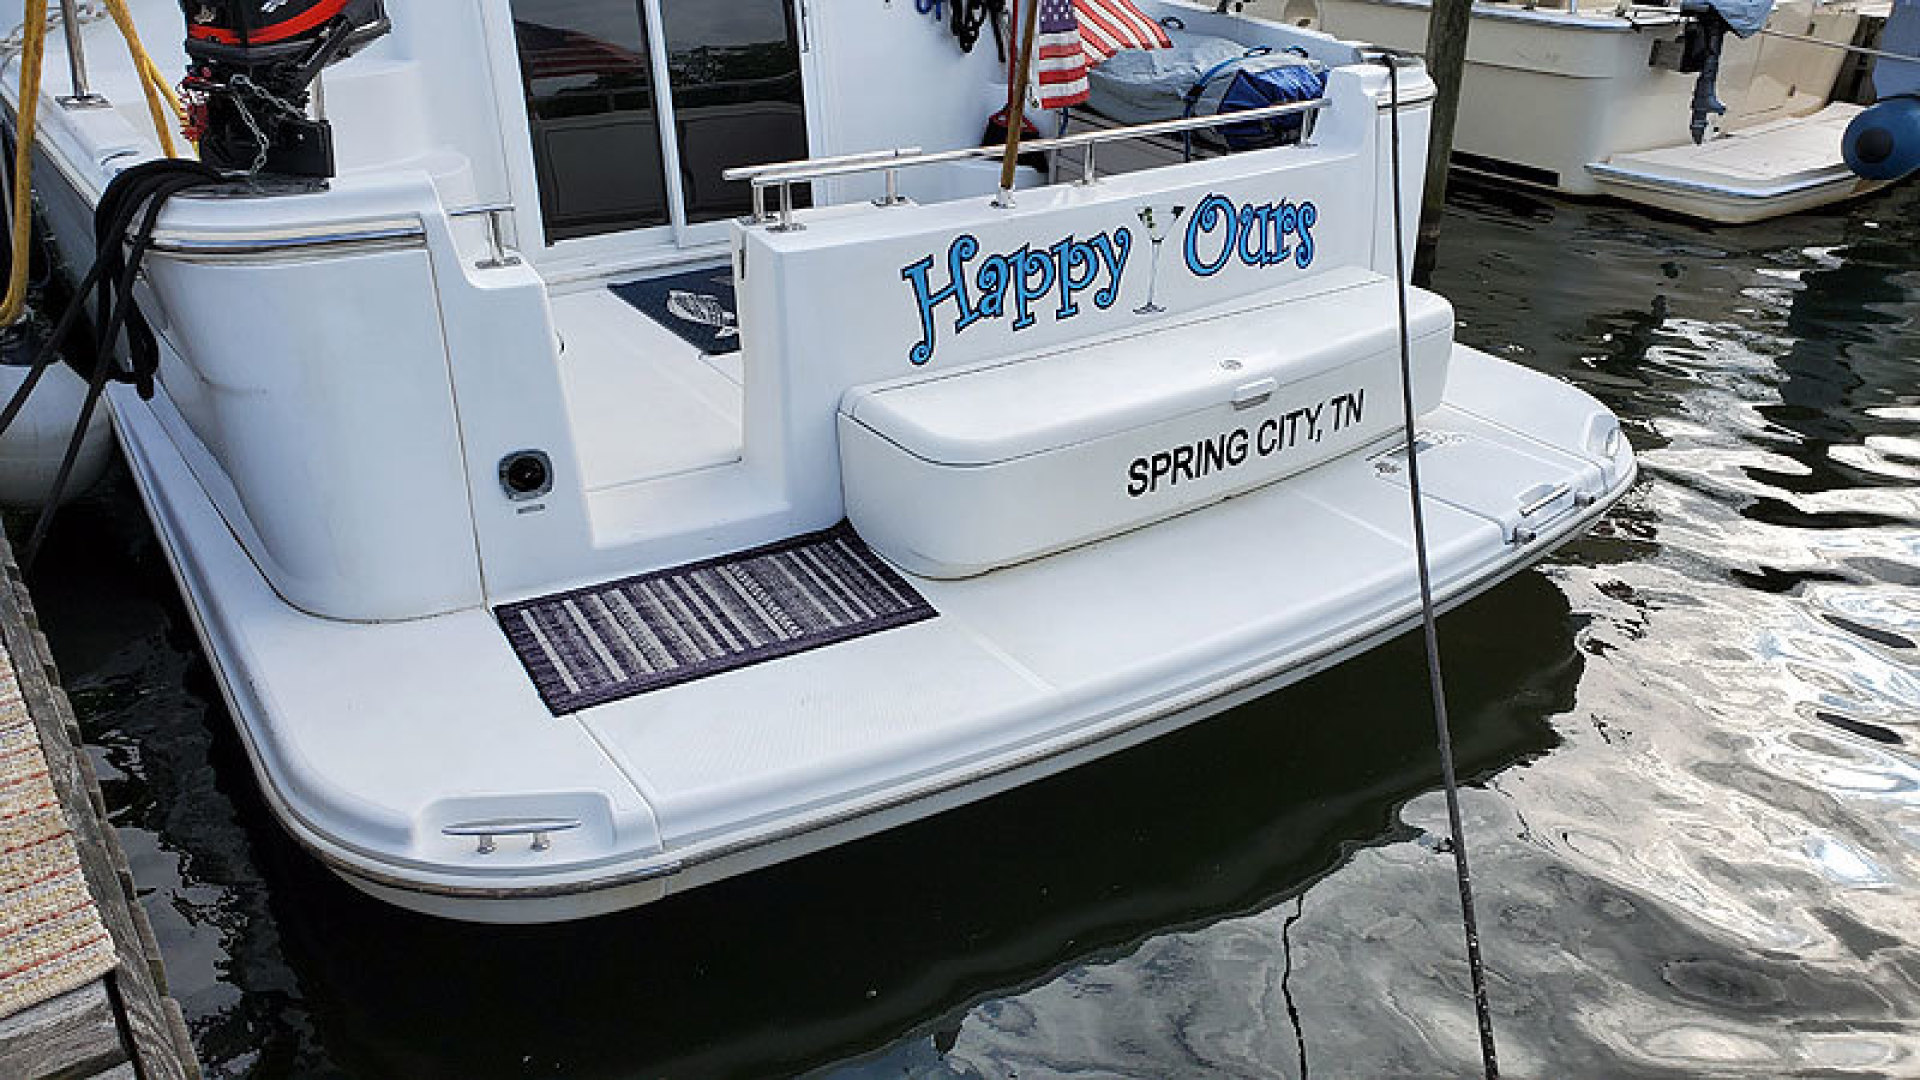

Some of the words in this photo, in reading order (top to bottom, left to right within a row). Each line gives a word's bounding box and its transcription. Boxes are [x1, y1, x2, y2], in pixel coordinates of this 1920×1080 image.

[901, 226, 1131, 365] Happy
[1184, 194, 1317, 276] Ours
[1127, 428, 1249, 498] SPRING
[1256, 402, 1323, 457] CITY,
[1331, 388, 1364, 432] TN
